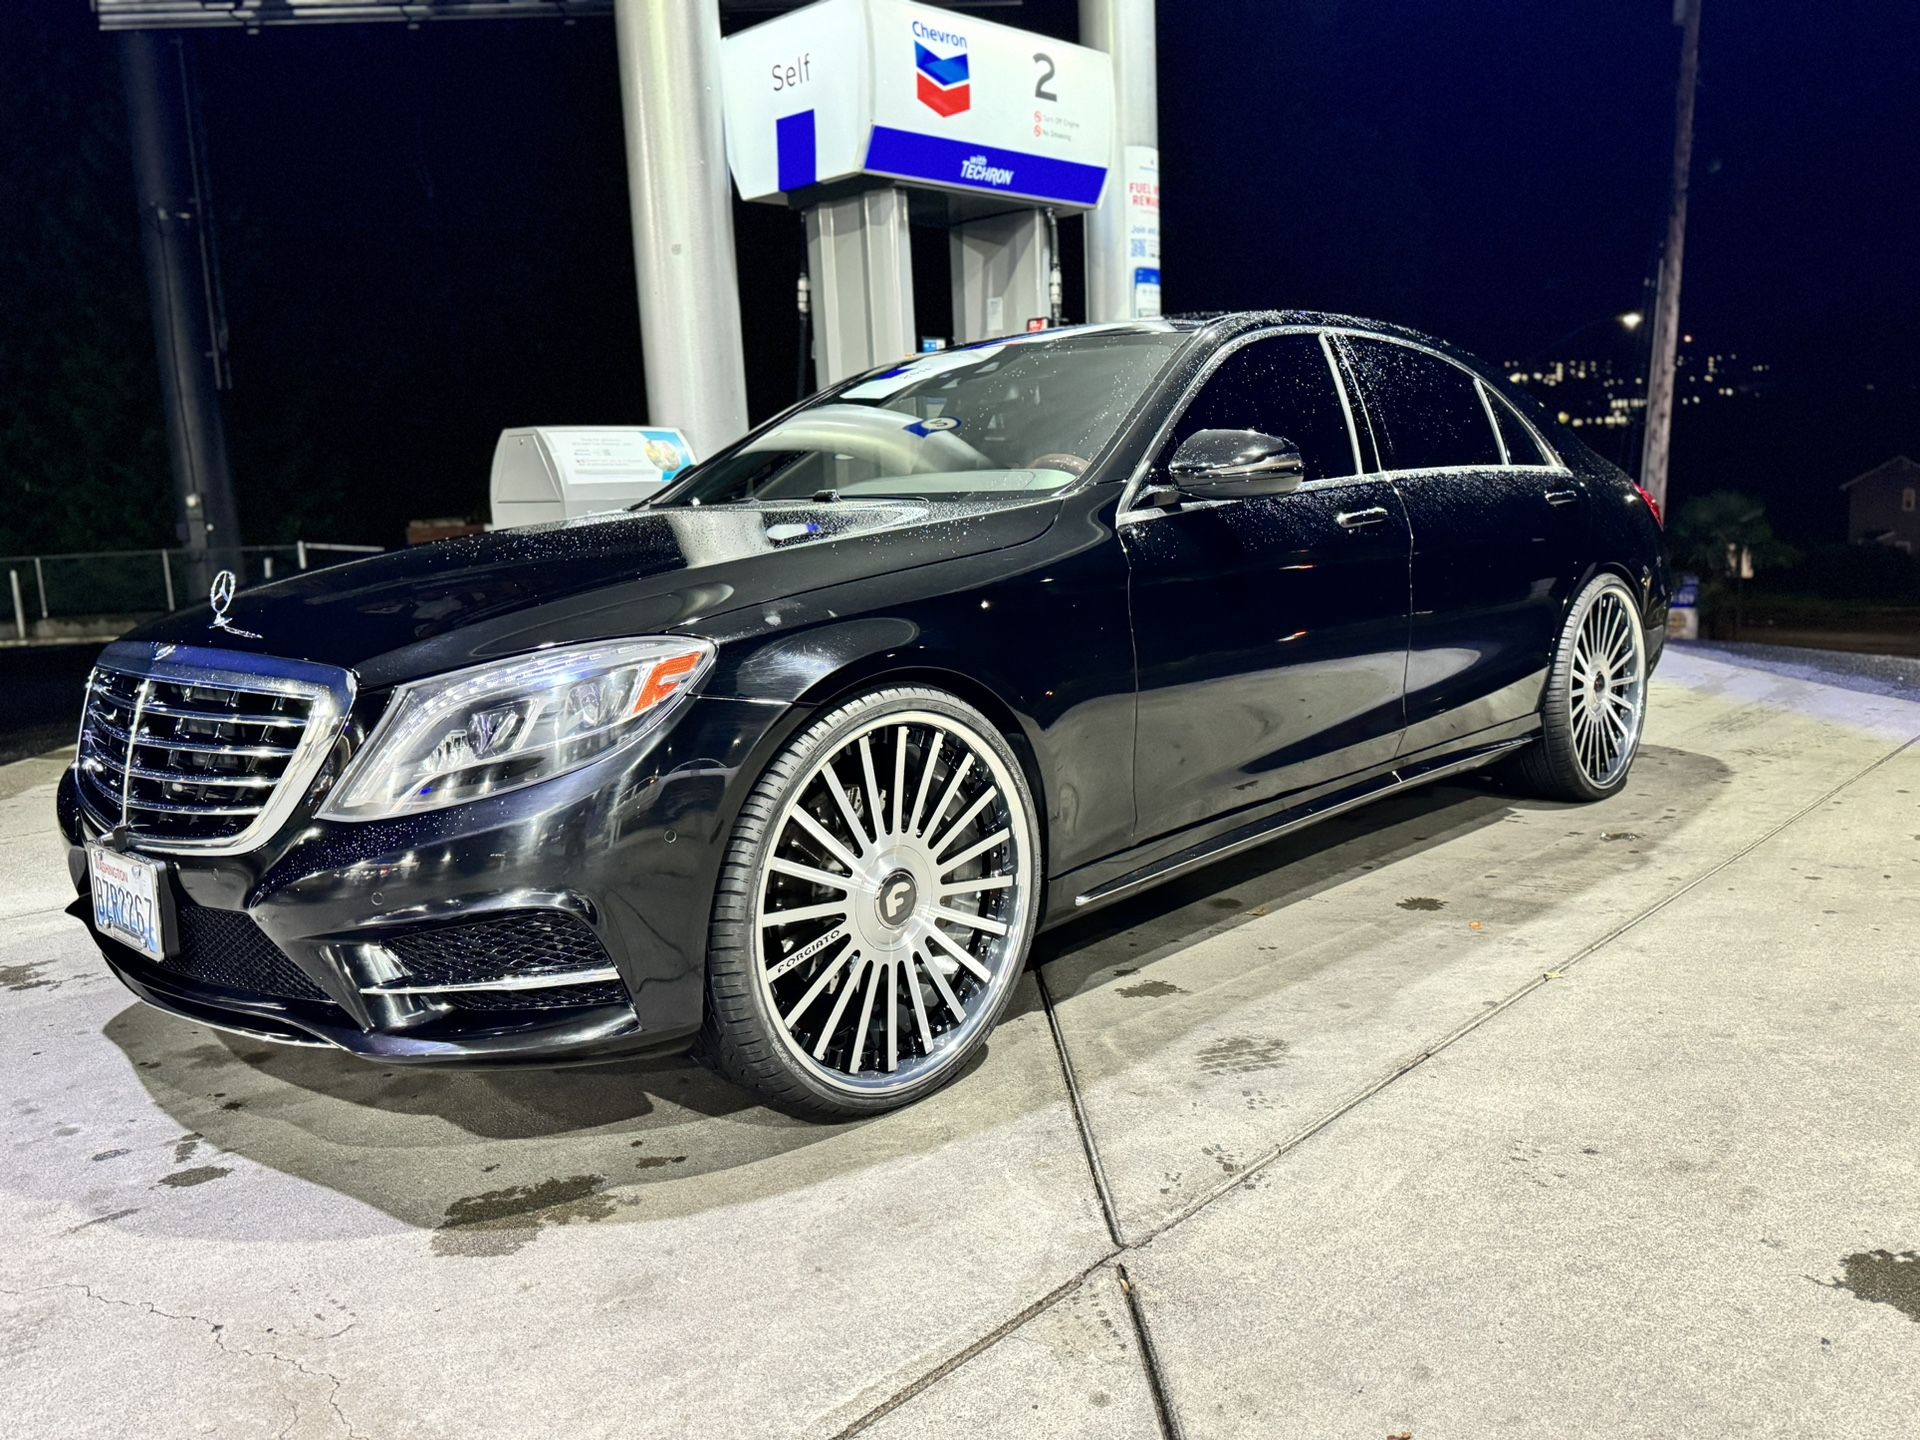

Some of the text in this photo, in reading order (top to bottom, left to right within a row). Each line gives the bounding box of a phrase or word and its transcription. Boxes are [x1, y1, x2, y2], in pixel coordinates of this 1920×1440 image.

[912, 21, 968, 48] Chevron
[771, 53, 811, 92] Self
[1032, 53, 1058, 102] 2
[960, 160, 1015, 186] TECHRON
[969, 154, 988, 166] with
[1129, 182, 1151, 194] FUEL
[95, 876, 153, 940] BZR2267
[777, 929, 840, 974] FORGIATO
